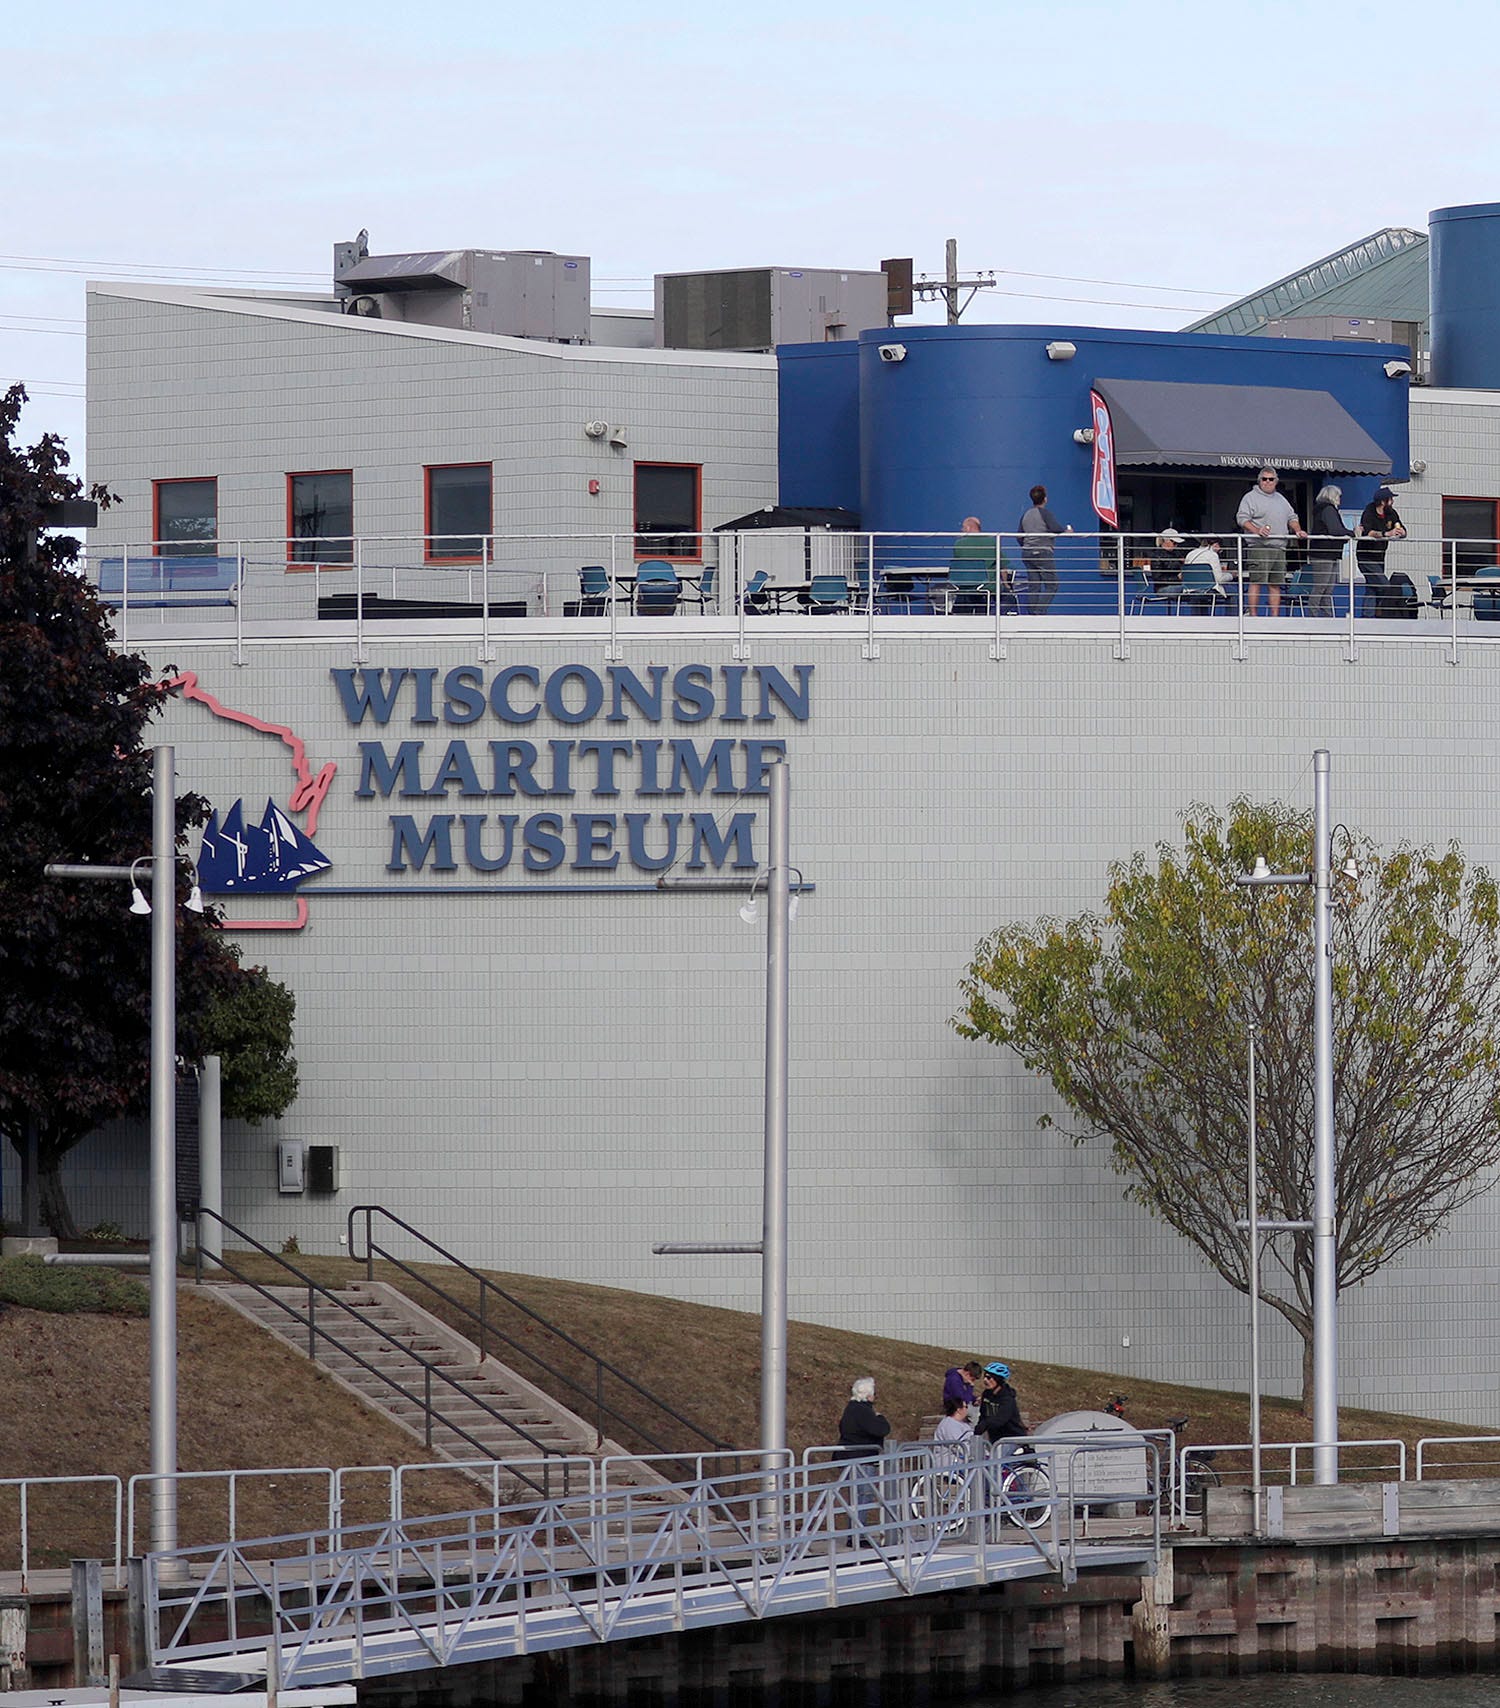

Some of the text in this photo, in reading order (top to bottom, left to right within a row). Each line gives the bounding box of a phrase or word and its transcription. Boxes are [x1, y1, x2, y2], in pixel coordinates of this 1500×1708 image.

[1220, 455, 1333, 469] WISCONSIN MARITIME MUSEUM
[329, 664, 816, 724] WISCONSIN
[354, 738, 788, 796] MARITIME
[385, 812, 759, 872] MUSEUM
